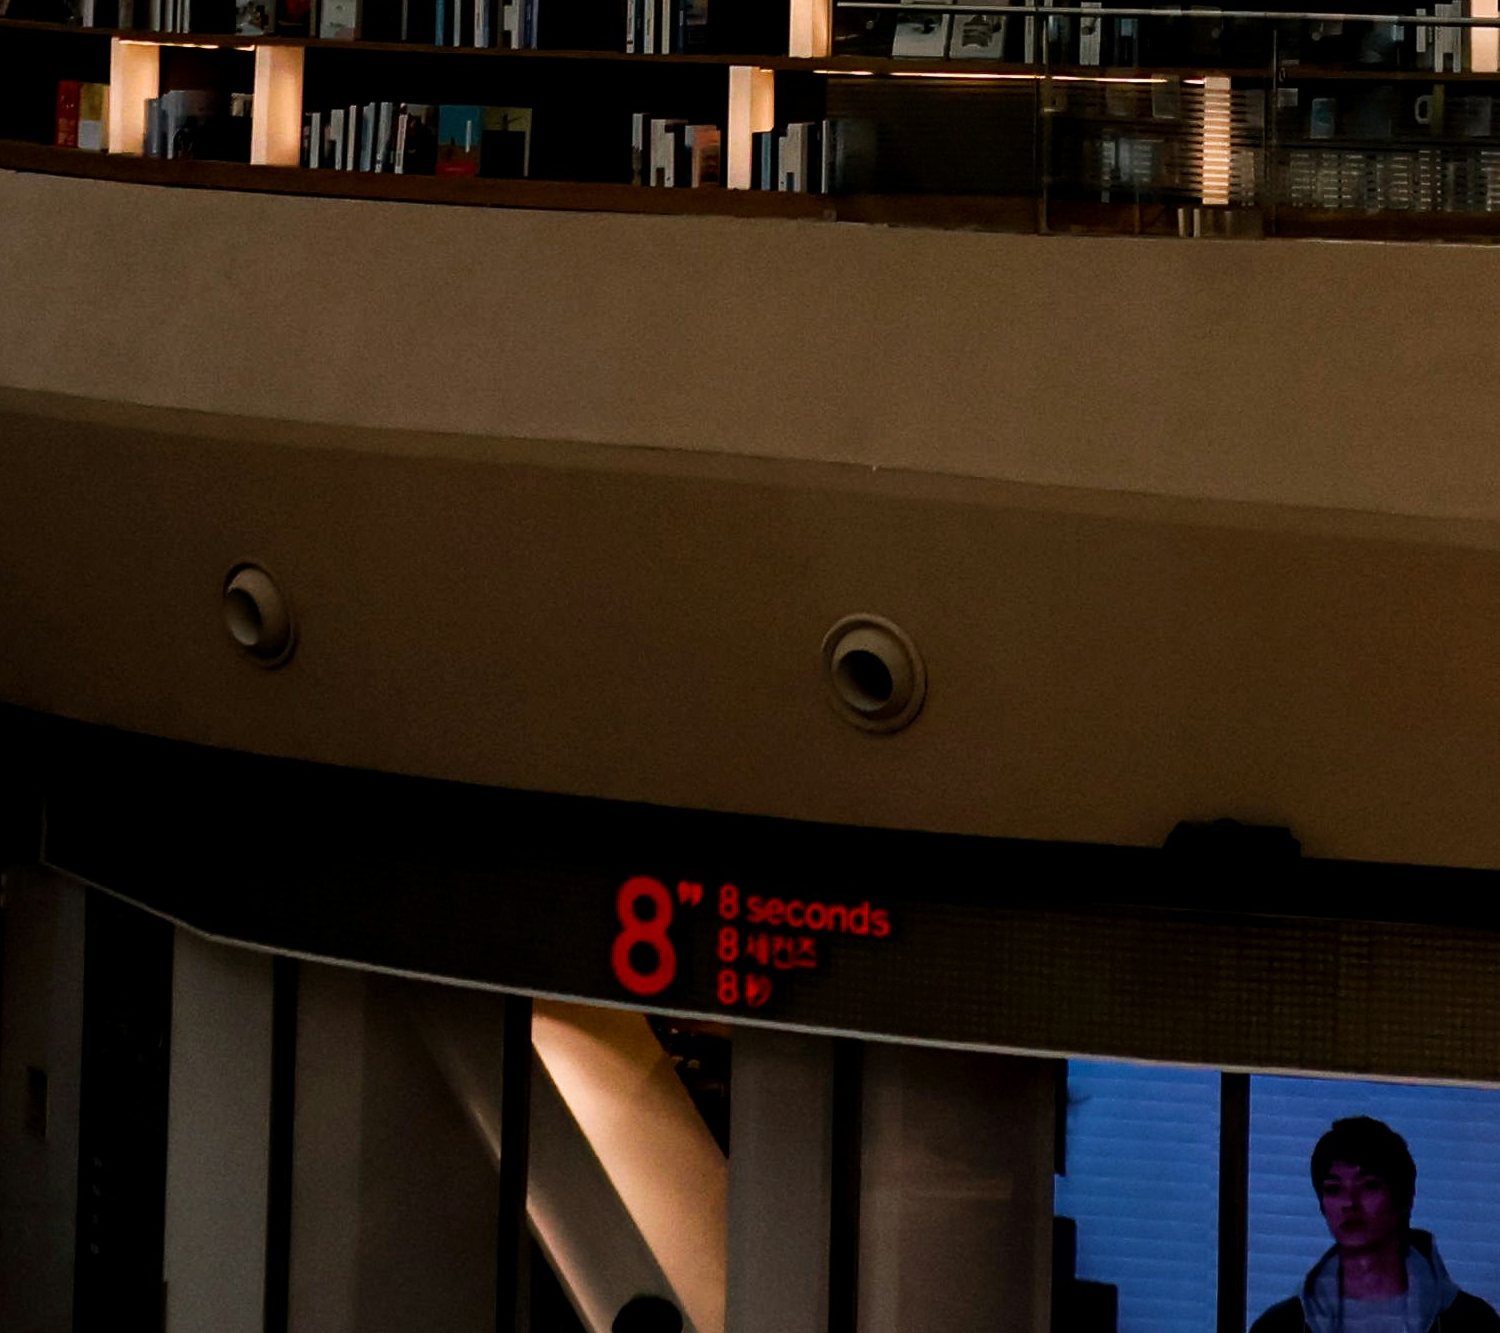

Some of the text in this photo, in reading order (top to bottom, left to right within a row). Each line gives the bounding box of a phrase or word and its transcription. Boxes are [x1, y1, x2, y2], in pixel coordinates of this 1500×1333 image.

[717, 883, 892, 939] 8 seconds
[716, 923, 740, 964] 8
[715, 964, 741, 1006] 8
